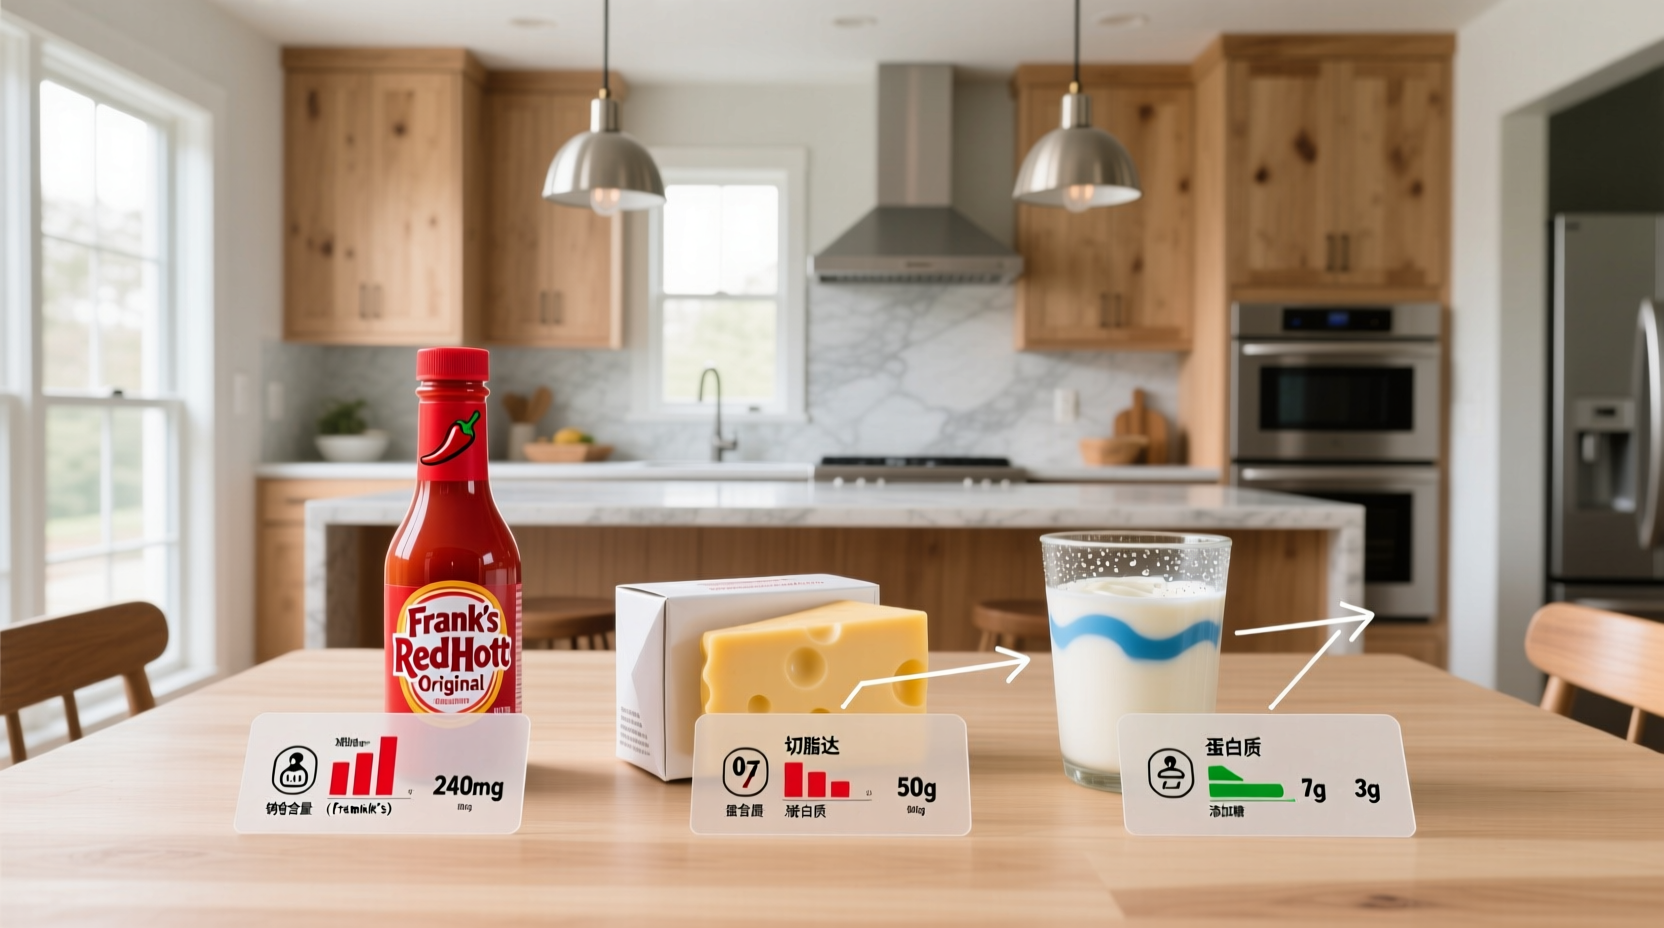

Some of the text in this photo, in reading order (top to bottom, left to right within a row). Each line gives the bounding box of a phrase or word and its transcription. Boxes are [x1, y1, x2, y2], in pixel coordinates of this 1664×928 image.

[408, 604, 499, 638] Frank's
[395, 636, 510, 679] RedHott
[418, 674, 484, 696] Original
